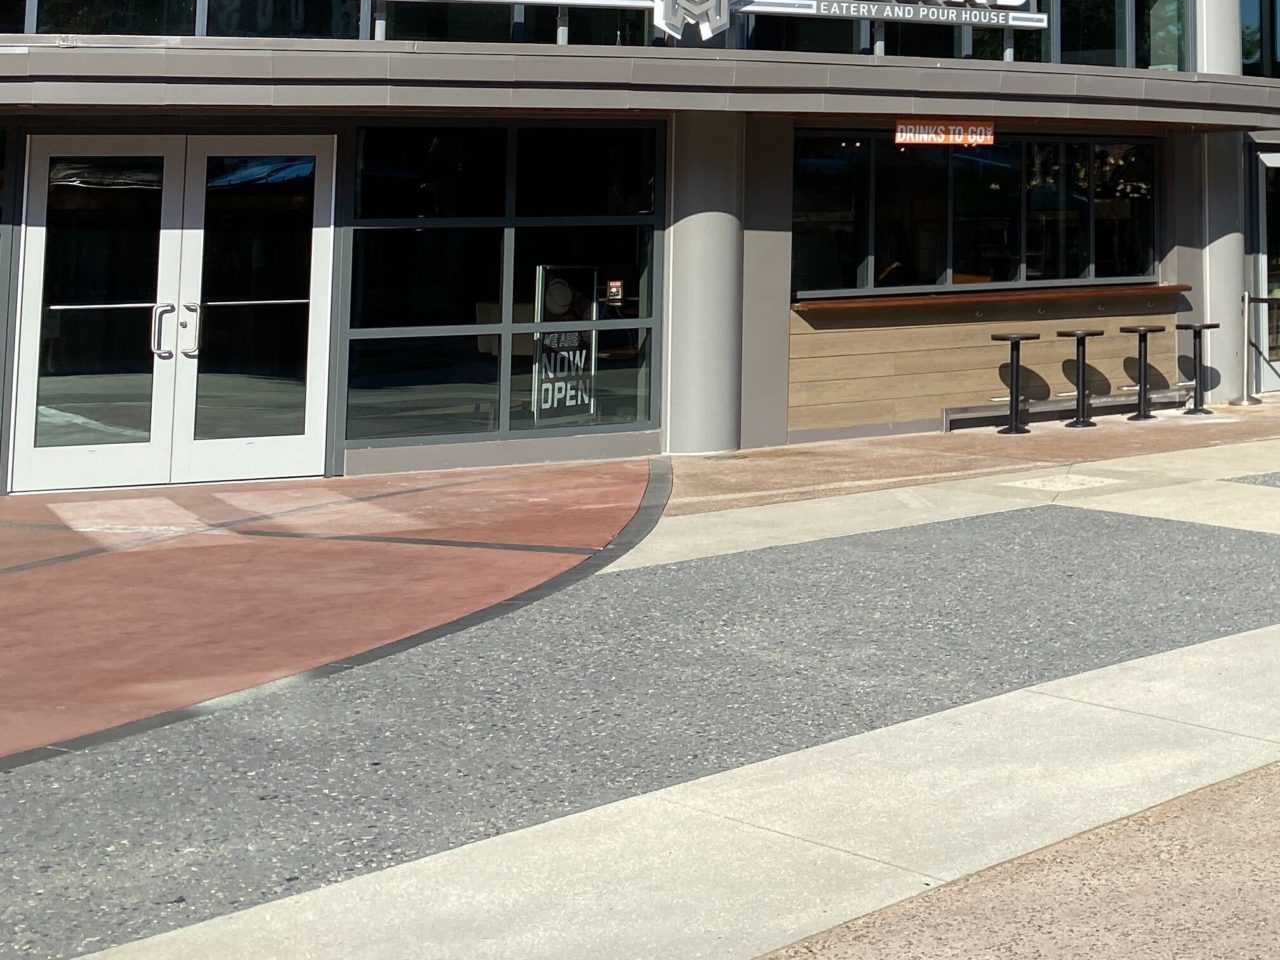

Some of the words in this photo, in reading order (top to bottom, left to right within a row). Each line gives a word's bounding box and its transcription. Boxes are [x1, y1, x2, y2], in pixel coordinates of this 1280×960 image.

[820, 2, 879, 16] EATERY
[883, 5, 914, 19] AND
[919, 7, 957, 21] POUR
[961, 11, 1006, 24] HOUSE
[896, 124, 945, 142] DRINKS
[947, 125, 985, 143] TO-GO
[542, 349, 587, 379] NOW
[541, 378, 590, 410] OPEN
